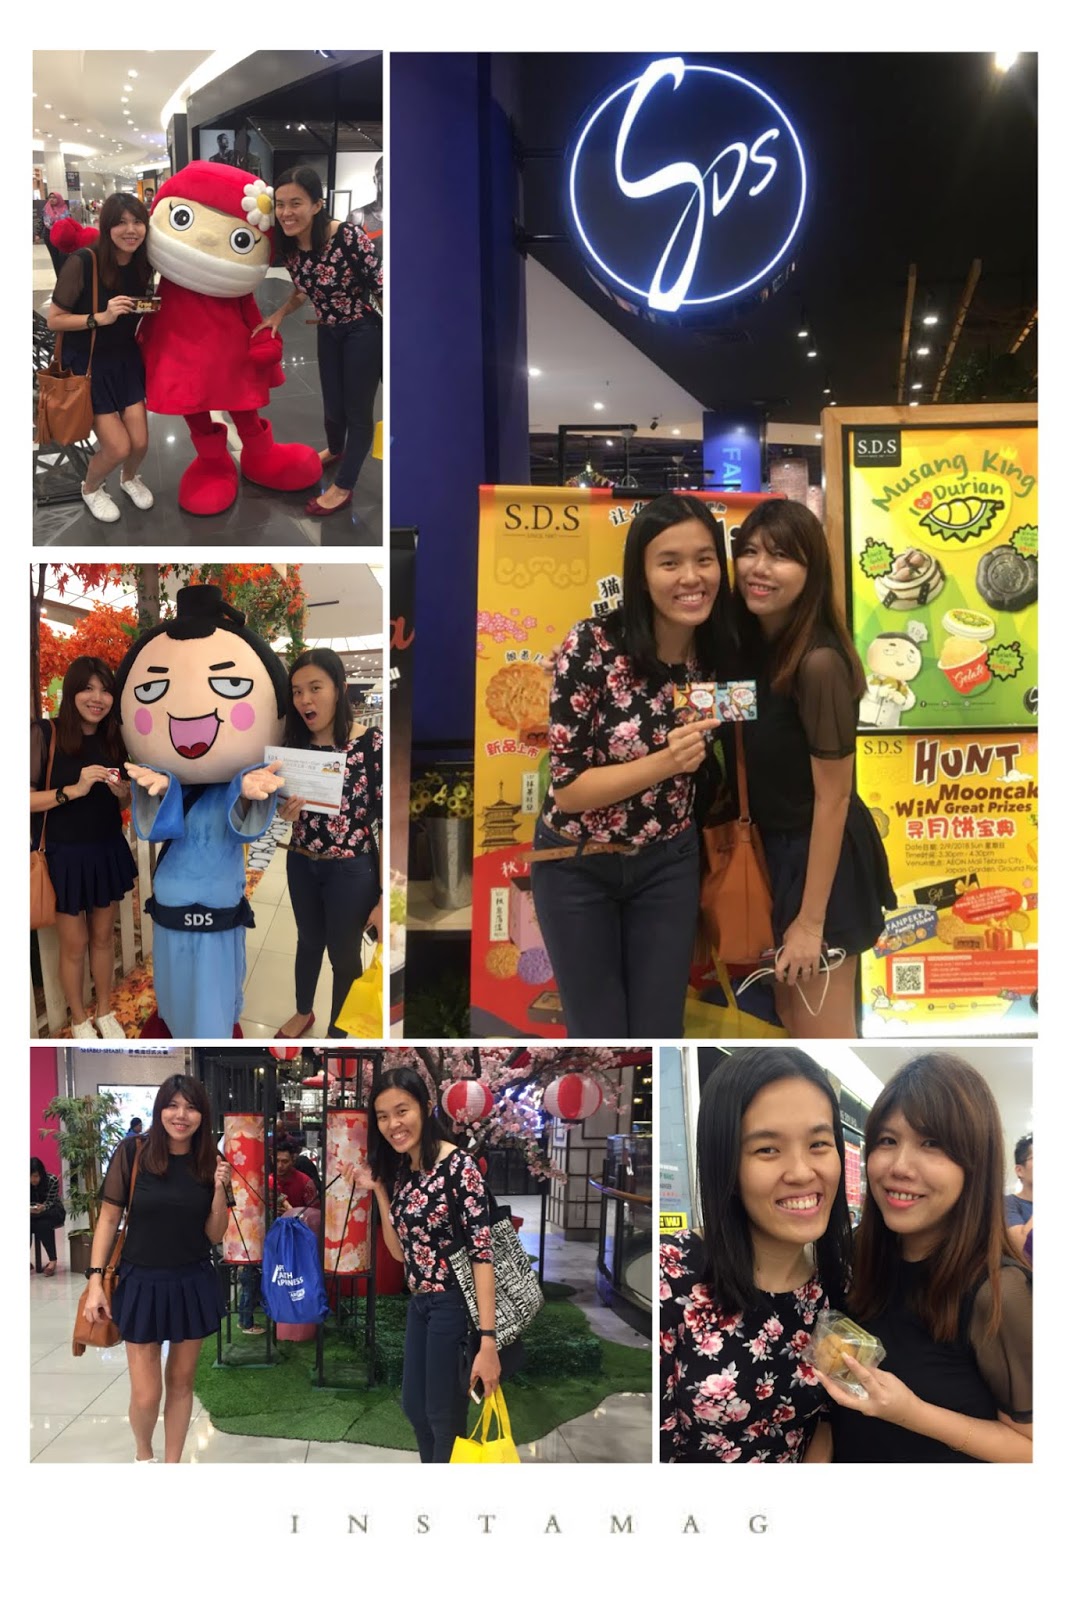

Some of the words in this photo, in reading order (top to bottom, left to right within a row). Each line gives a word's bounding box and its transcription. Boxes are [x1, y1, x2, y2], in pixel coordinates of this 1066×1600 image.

[857, 439, 897, 454] S.D.S
[872, 454, 969, 512] Musang
[981, 449, 1036, 499] King
[932, 477, 1004, 499] Durian
[504, 503, 580, 531] S.D.S
[486, 738, 539, 757] 新品上市
[863, 740, 903, 755] S.D.S
[914, 739, 1021, 785] HUNT
[944, 802, 984, 815] Great
[988, 800, 1032, 813] Prizes
[184, 912, 214, 926] SDS
